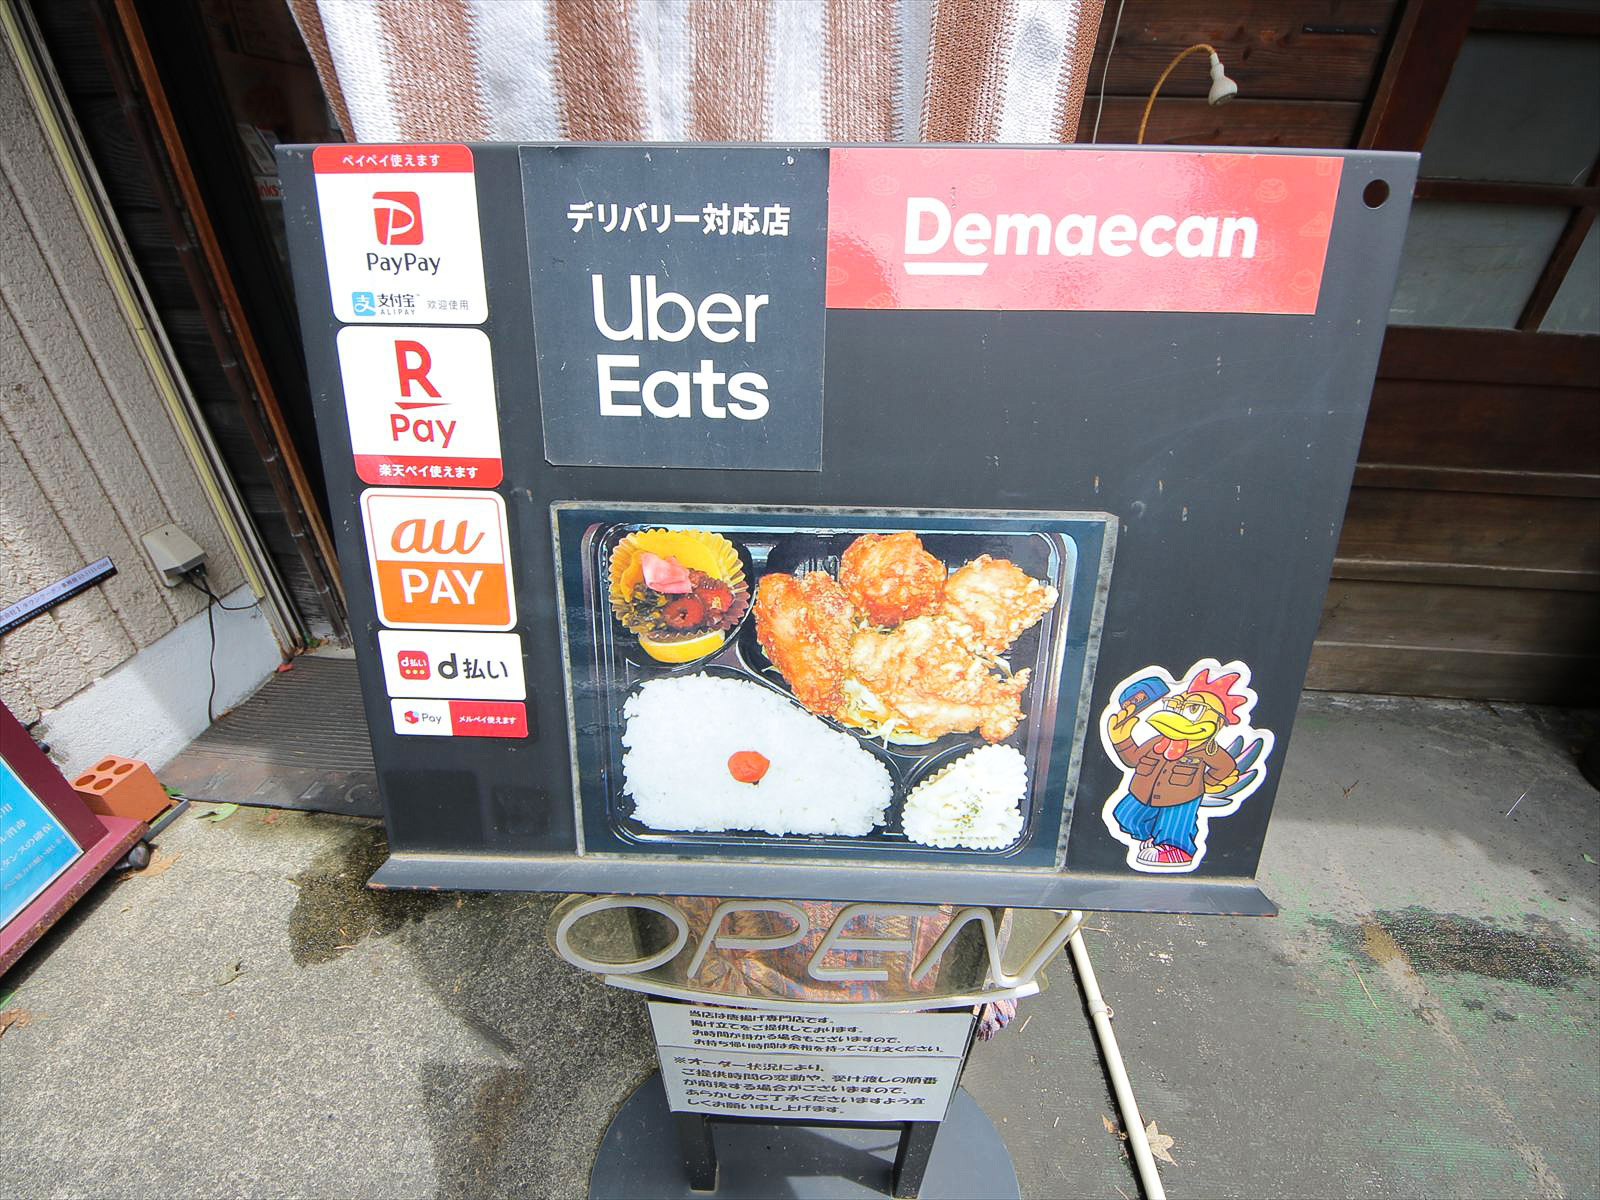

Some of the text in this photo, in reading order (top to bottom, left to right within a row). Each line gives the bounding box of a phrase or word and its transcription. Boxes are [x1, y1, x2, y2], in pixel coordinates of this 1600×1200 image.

[342, 153, 440, 167] ペイペイ使えます
[567, 201, 791, 236] デリバリー対応店
[904, 197, 1258, 258] Demaecan
[366, 252, 441, 275] PayPay
[377, 293, 415, 307] 支付宝
[381, 308, 415, 316] ALIPAY
[592, 274, 769, 343] Uber
[395, 340, 442, 398] R
[597, 354, 770, 420] Eats
[390, 413, 456, 449] Pay
[379, 464, 478, 478] 楽天ペイ使えます
[391, 518, 485, 555] au
[400, 568, 483, 605] PAY
[438, 653, 508, 679] d払い
[422, 712, 442, 725] Pay
[556, 897, 1083, 988] OPEN
